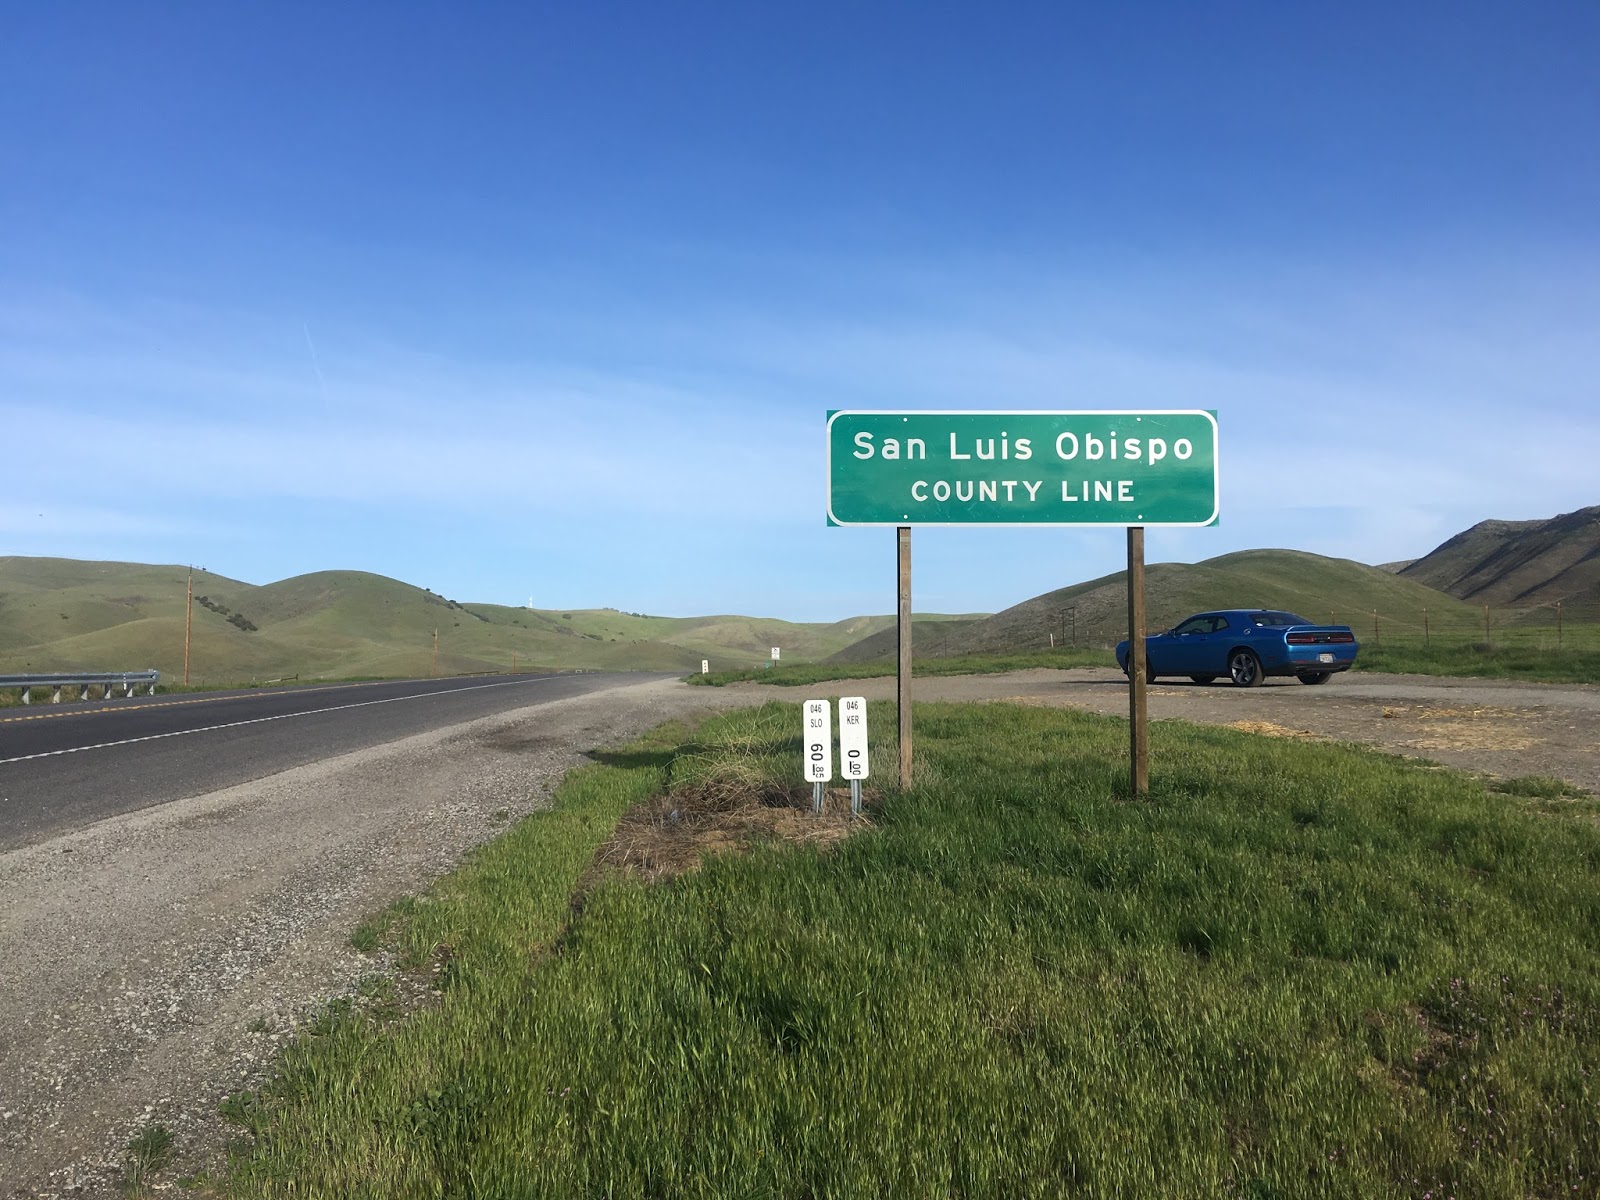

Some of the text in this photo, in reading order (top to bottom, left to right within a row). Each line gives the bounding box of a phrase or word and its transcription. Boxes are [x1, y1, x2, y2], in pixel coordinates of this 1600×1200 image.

[852, 430, 1193, 466] San Luis Obispo
[911, 480, 1135, 502] COUNTY LINE
[810, 704, 822, 713] 046
[847, 701, 858, 710] 046
[810, 718, 823, 728] SLO
[847, 715, 859, 724] KER
